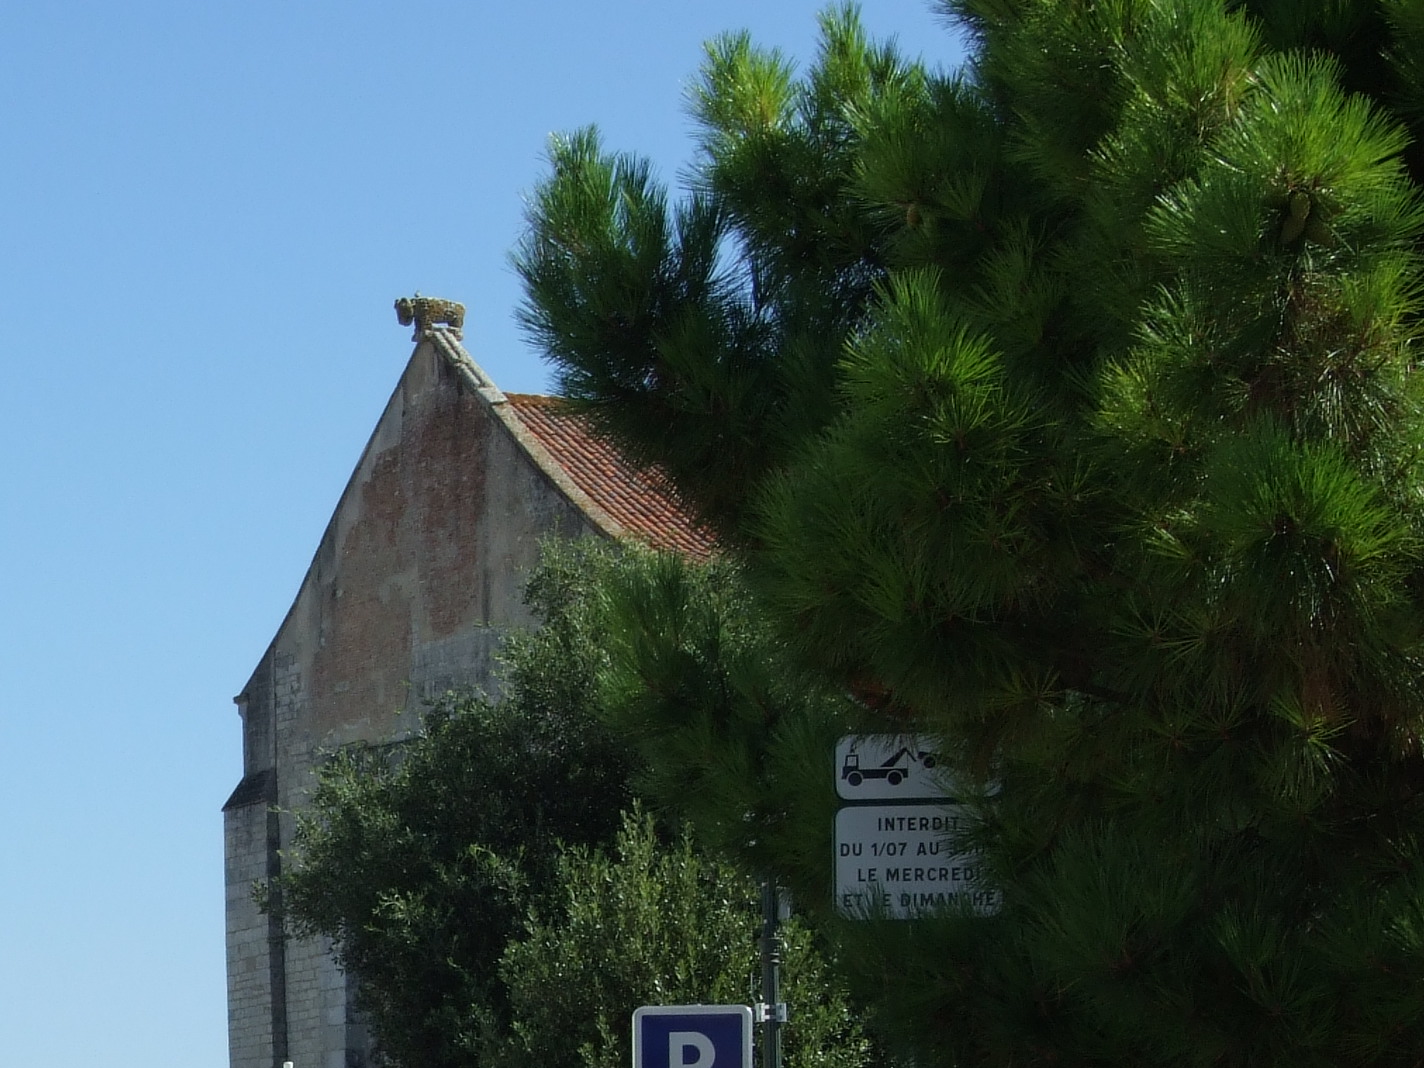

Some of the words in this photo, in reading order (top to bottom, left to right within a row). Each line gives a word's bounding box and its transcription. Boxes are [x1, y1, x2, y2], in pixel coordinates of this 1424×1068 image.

[878, 817, 960, 831] INTERDIT
[840, 843, 862, 857] DU
[871, 842, 907, 856] 1/07
[917, 842, 940, 856] AU
[858, 868, 877, 882] LE
[886, 867, 974, 882] MERCRED
[900, 893, 995, 907] DIMANHE
